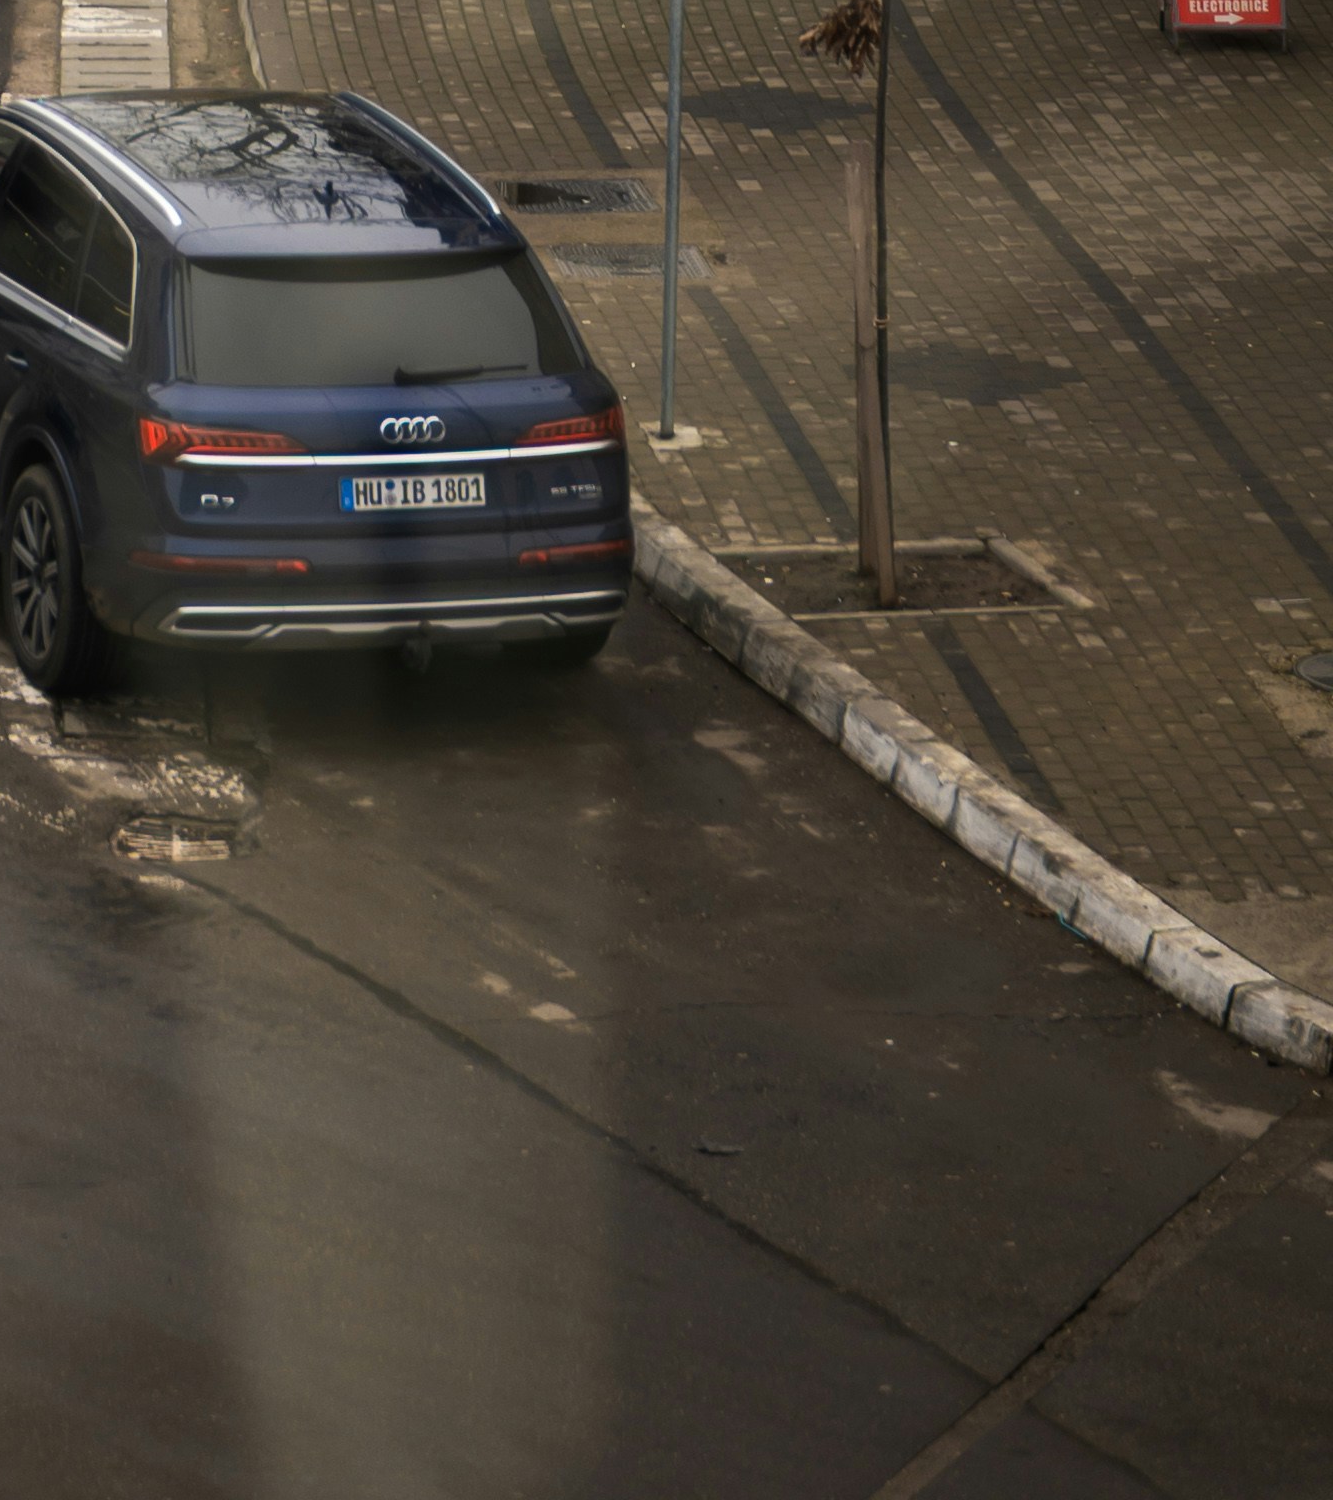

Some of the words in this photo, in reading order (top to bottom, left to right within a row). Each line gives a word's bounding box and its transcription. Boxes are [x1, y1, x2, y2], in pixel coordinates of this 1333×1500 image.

[1189, 0, 1269, 13] ELECTRONICE
[355, 477, 382, 507] HU
[401, 476, 426, 505] IB
[432, 476, 484, 504] 1801
